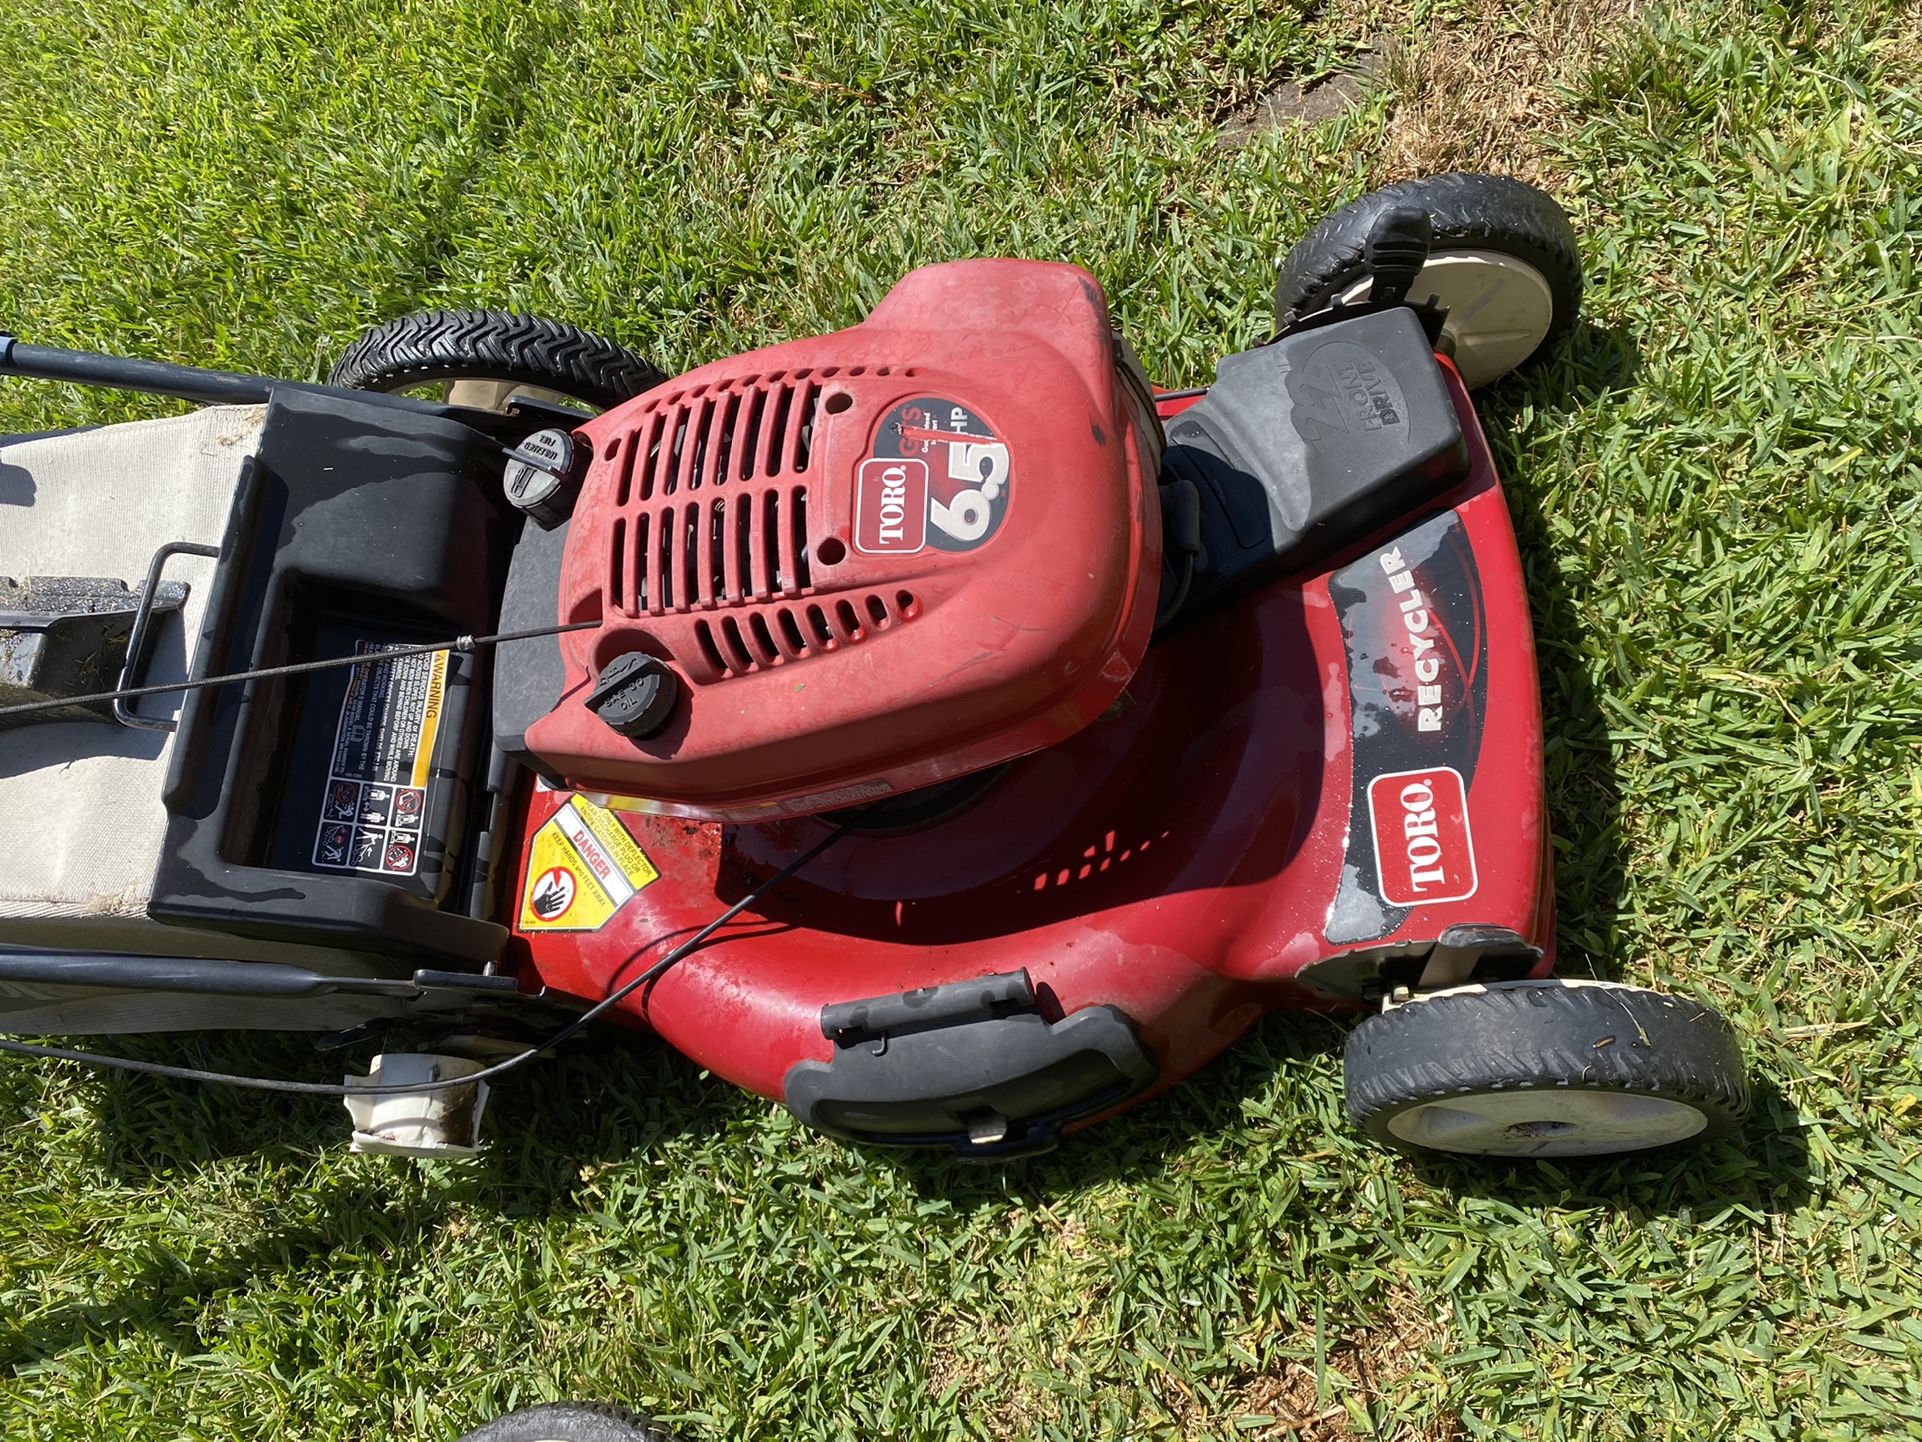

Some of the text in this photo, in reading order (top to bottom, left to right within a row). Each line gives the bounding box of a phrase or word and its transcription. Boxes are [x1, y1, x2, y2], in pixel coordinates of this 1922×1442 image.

[1338, 365, 1383, 432] FRONT
[1356, 361, 1401, 426] DRIVE
[900, 406, 922, 457] GS
[951, 406, 968, 433] HP
[878, 466, 907, 545] TORO
[930, 441, 1010, 541] 6.5
[1380, 545, 1444, 732] RECYCLER
[417, 670, 428, 700] SERIOUS
[425, 662, 445, 719] WARNING
[604, 677, 645, 708] SAE 30
[620, 698, 638, 711] OIL
[367, 702, 376, 722] COULD
[411, 724, 417, 732] or
[413, 700, 423, 723] INJURY
[407, 733, 417, 758] DEATH:
[580, 806, 595, 825] ENTIRE
[593, 824, 615, 851] CATCHER
[617, 856, 633, 876] PLACE
[595, 815, 621, 848] DISCHARGE
[619, 846, 633, 864] PLUG
[631, 862, 640, 872] OR
[602, 812, 615, 827] ONLY
[613, 827, 626, 842] WITH
[1400, 780, 1446, 894] TORO
[551, 832, 563, 847] KEEP
[561, 846, 577, 865] HANDS
[581, 875, 593, 889] FEET
[592, 890, 606, 906] AWAY
[571, 829, 612, 879] DANGER
